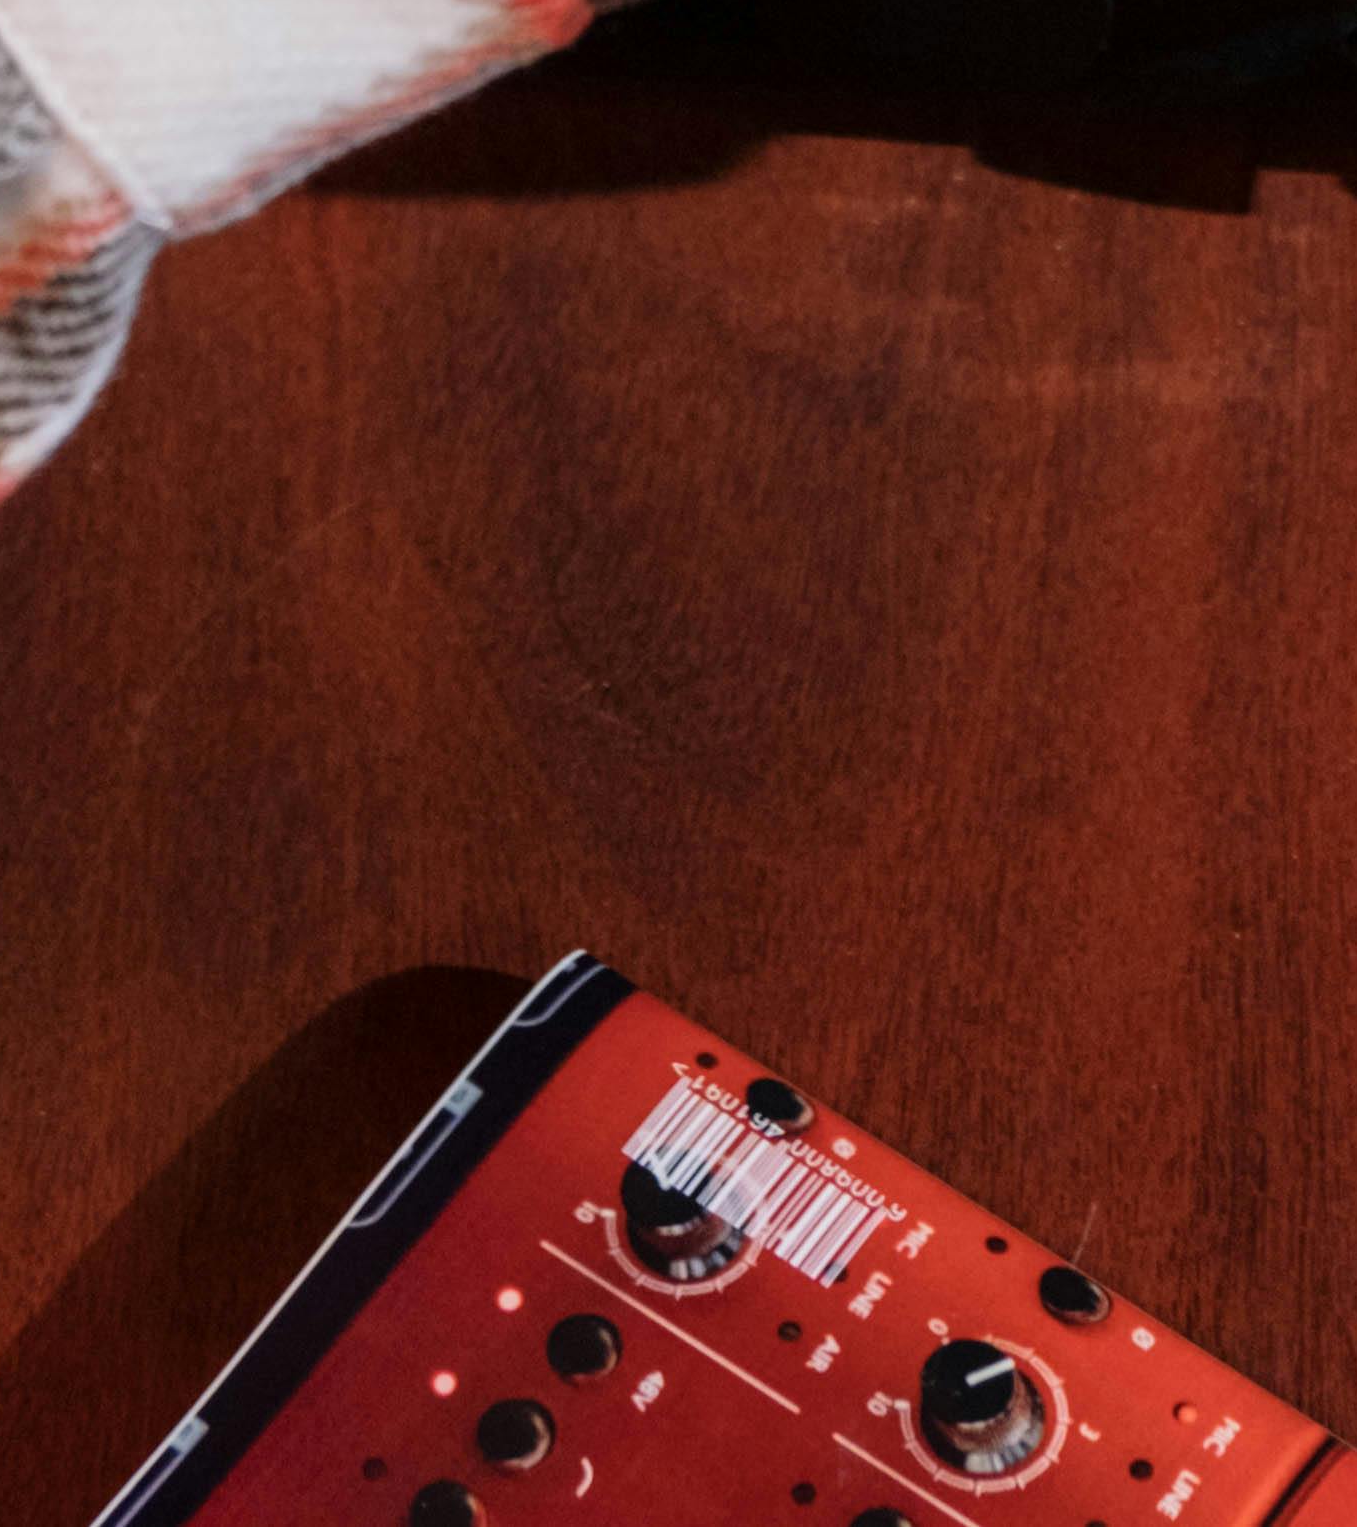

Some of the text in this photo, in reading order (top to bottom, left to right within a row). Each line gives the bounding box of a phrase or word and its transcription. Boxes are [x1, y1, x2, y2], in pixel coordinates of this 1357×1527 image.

[895, 1221, 935, 1260] MIC
[847, 1271, 892, 1320] LINE
[805, 1334, 841, 1374] AIR
[631, 1371, 665, 1413] 48V
[1202, 1416, 1242, 1458] MIC
[1156, 1469, 1201, 1521] LINE
